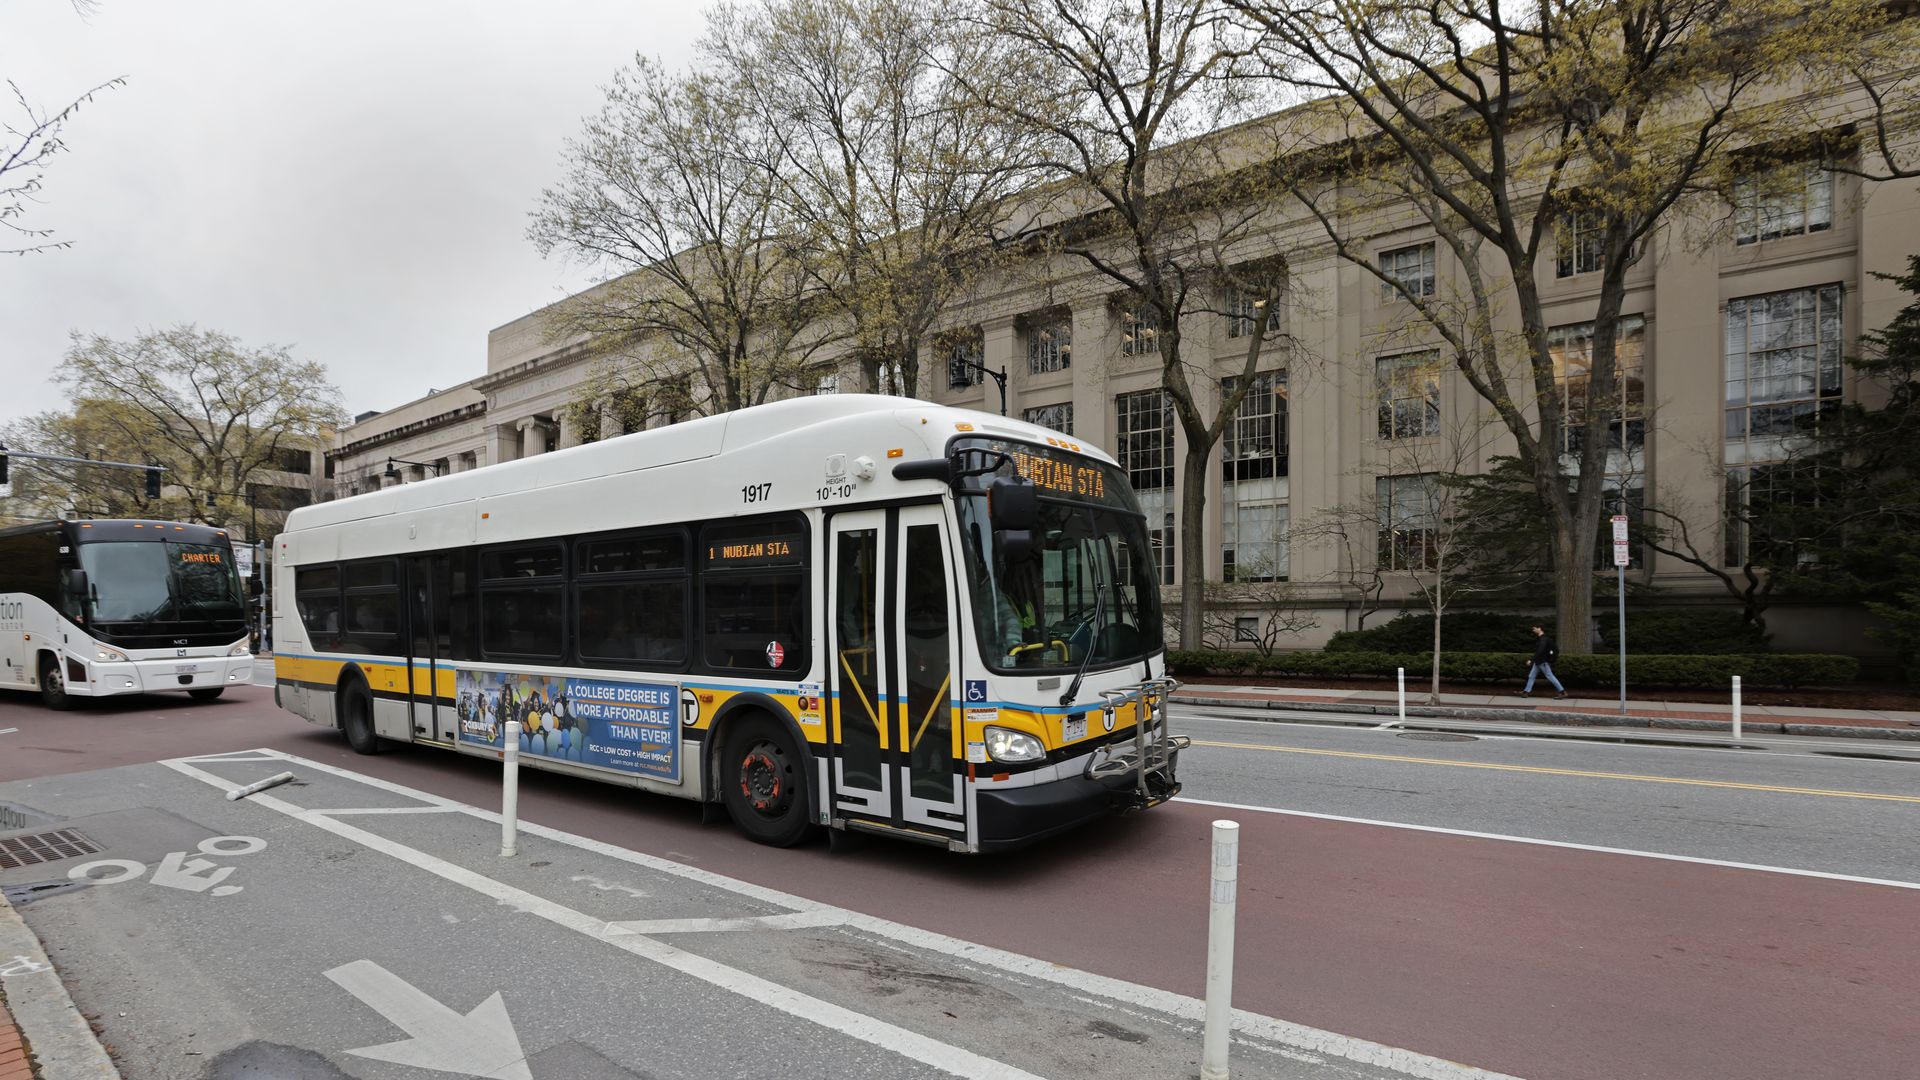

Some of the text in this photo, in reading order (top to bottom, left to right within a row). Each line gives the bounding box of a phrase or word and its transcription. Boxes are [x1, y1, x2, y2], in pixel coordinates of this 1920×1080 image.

[826, 476, 846, 485] HEIGHT
[1013, 451, 1073, 492] NUBIAN
[1077, 467, 1104, 498] STA
[741, 482, 772, 503] 1917
[181, 552, 221, 564] CHARTER
[709, 541, 790, 560] 1 NUBIAN STA
[567, 685, 670, 705] A COLLEGE DEGREE IS
[576, 703, 670, 725] MORE AFFORDABLE
[682, 698, 695, 721] T
[610, 725, 671, 744] THAN EVER!
[589, 743, 600, 752] RCC
[604, 746, 616, 755] LOW
[617, 748, 631, 757] COST
[636, 750, 651, 760] HIGH
[651, 752, 671, 763] IMPACT
